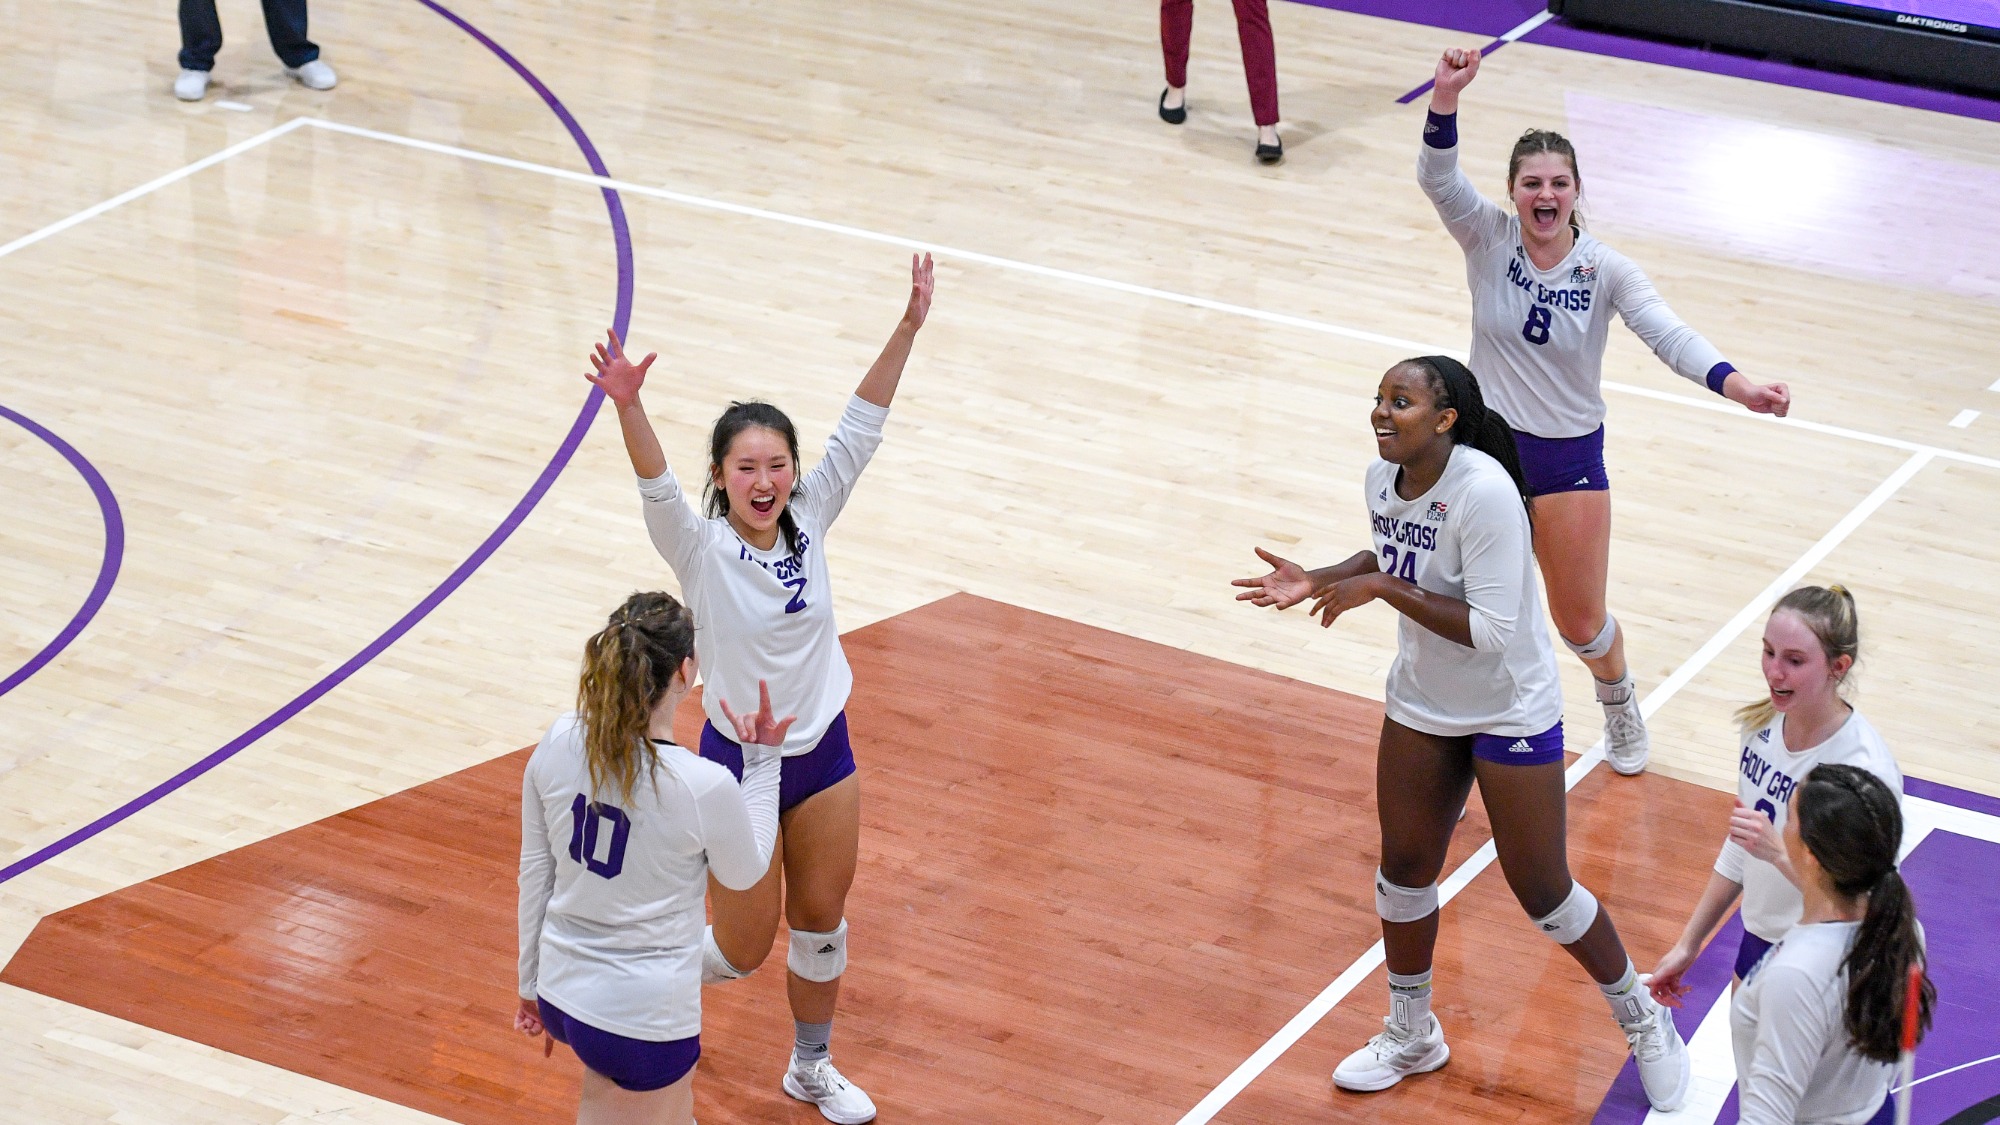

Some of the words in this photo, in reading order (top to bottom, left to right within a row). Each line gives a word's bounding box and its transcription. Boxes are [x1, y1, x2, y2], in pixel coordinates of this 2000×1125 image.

[1896, 14, 1968, 33] DAKTRONICS
[1506, 257, 1534, 292] HOY
[1537, 283, 1591, 311] CROSS
[1522, 303, 1552, 345] 8
[1371, 509, 1400, 539] HOLY
[1382, 543, 1418, 585] 24
[782, 577, 808, 614] 2
[1739, 746, 1772, 787] HOLY
[568, 792, 632, 880] 10
